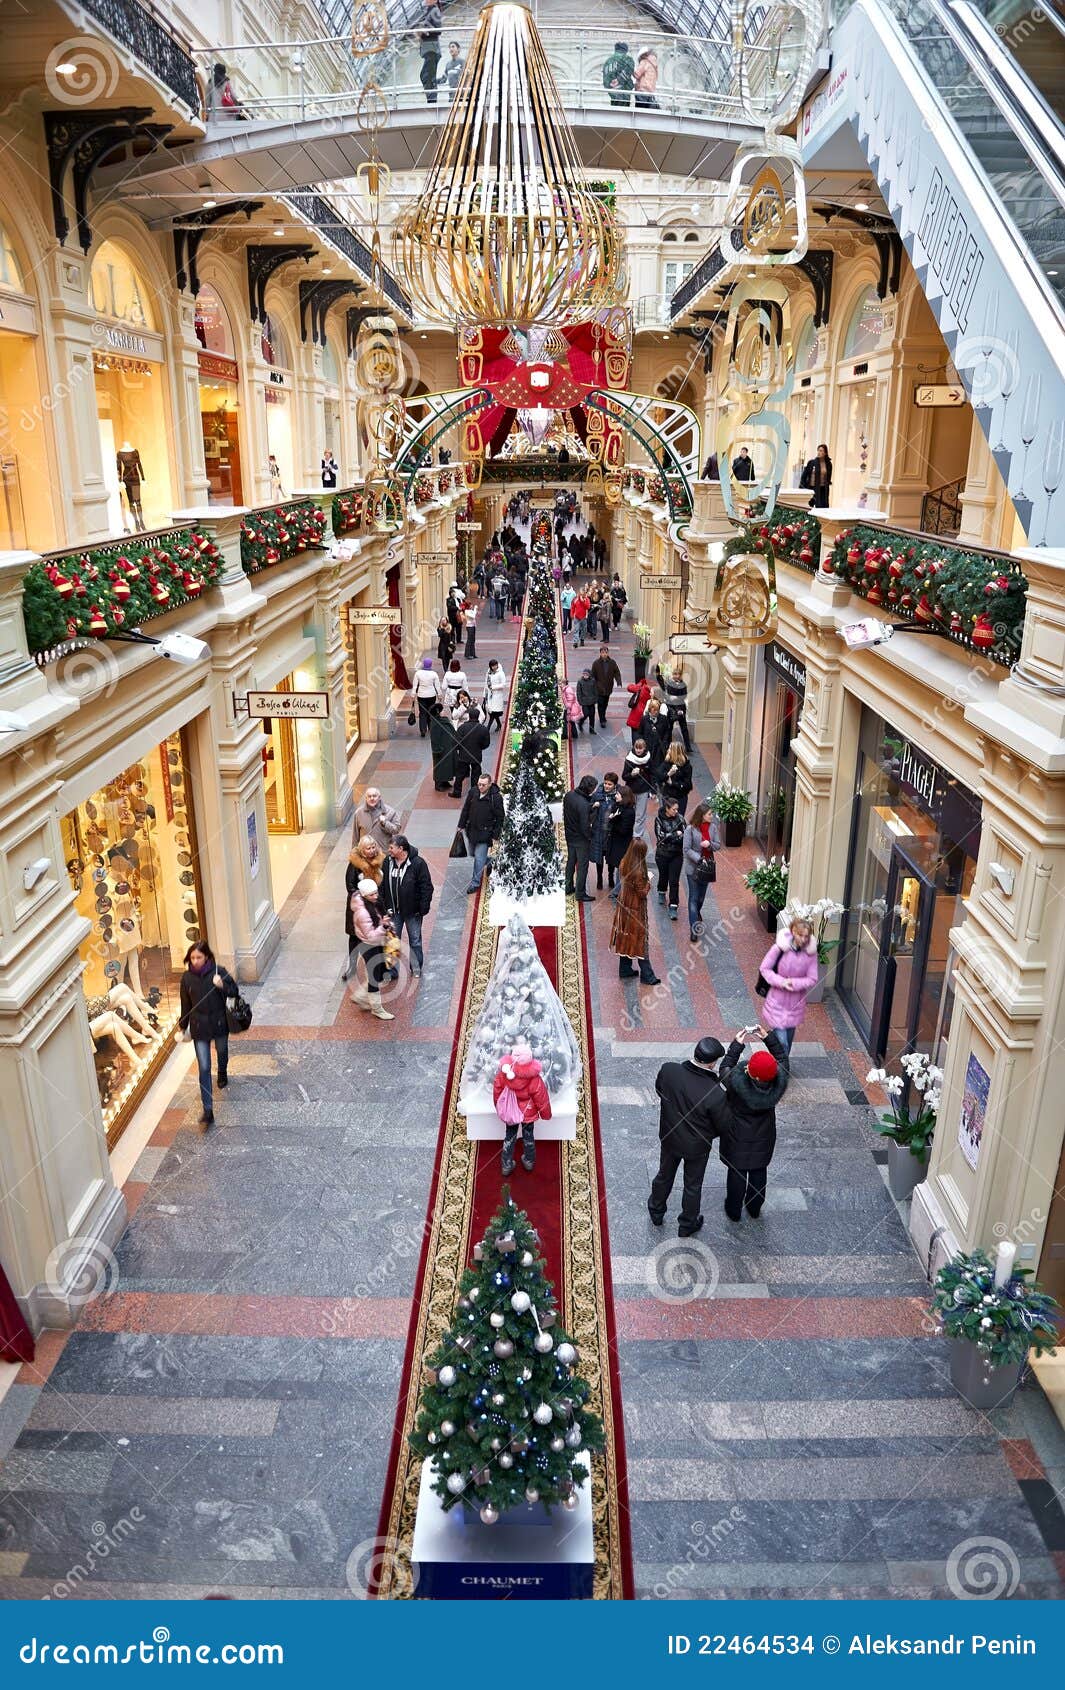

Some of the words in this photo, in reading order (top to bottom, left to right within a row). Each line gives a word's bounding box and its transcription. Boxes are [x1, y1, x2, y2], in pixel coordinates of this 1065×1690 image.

[917, 166, 985, 335] RIEDEL
[900, 742, 939, 809] PIAGET
[461, 1576, 544, 1585] CHAUMET
